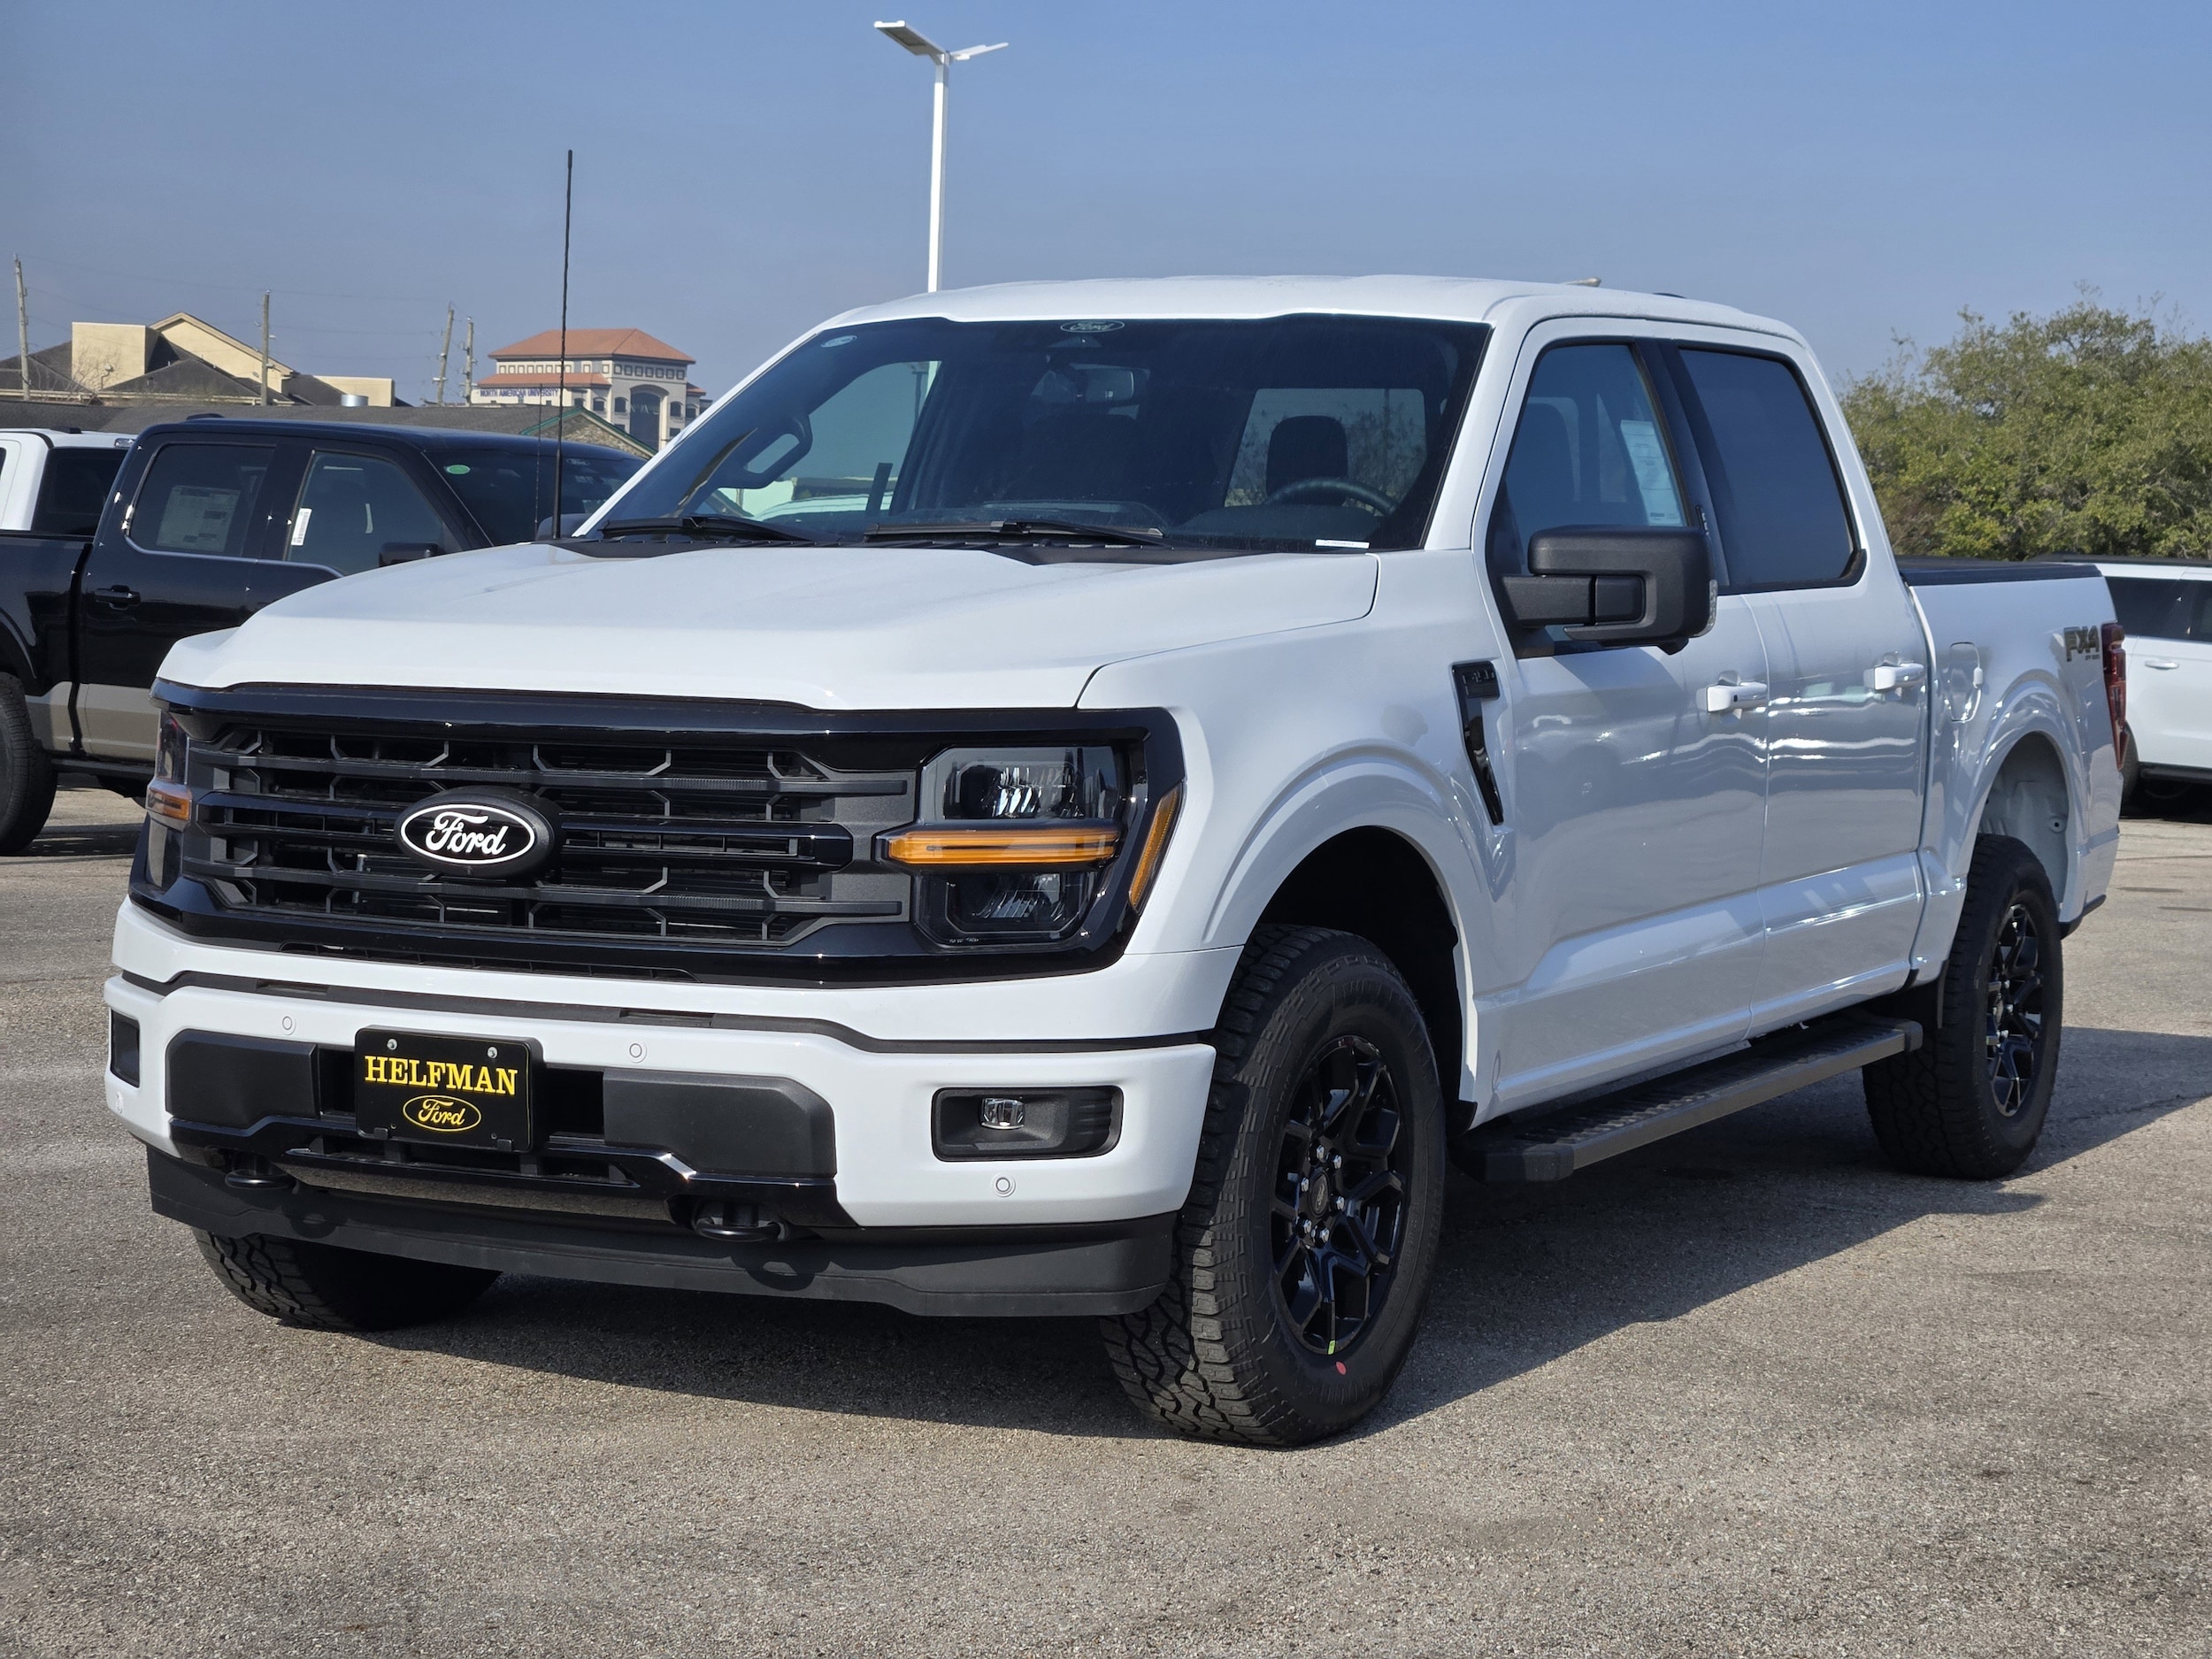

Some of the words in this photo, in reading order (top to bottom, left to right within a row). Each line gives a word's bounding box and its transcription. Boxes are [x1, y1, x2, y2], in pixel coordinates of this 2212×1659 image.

[2063, 626, 2100, 662] FX4
[426, 811, 509, 856] Ford
[365, 1056, 518, 1095] HELFMAN
[418, 1098, 466, 1125] Ford
